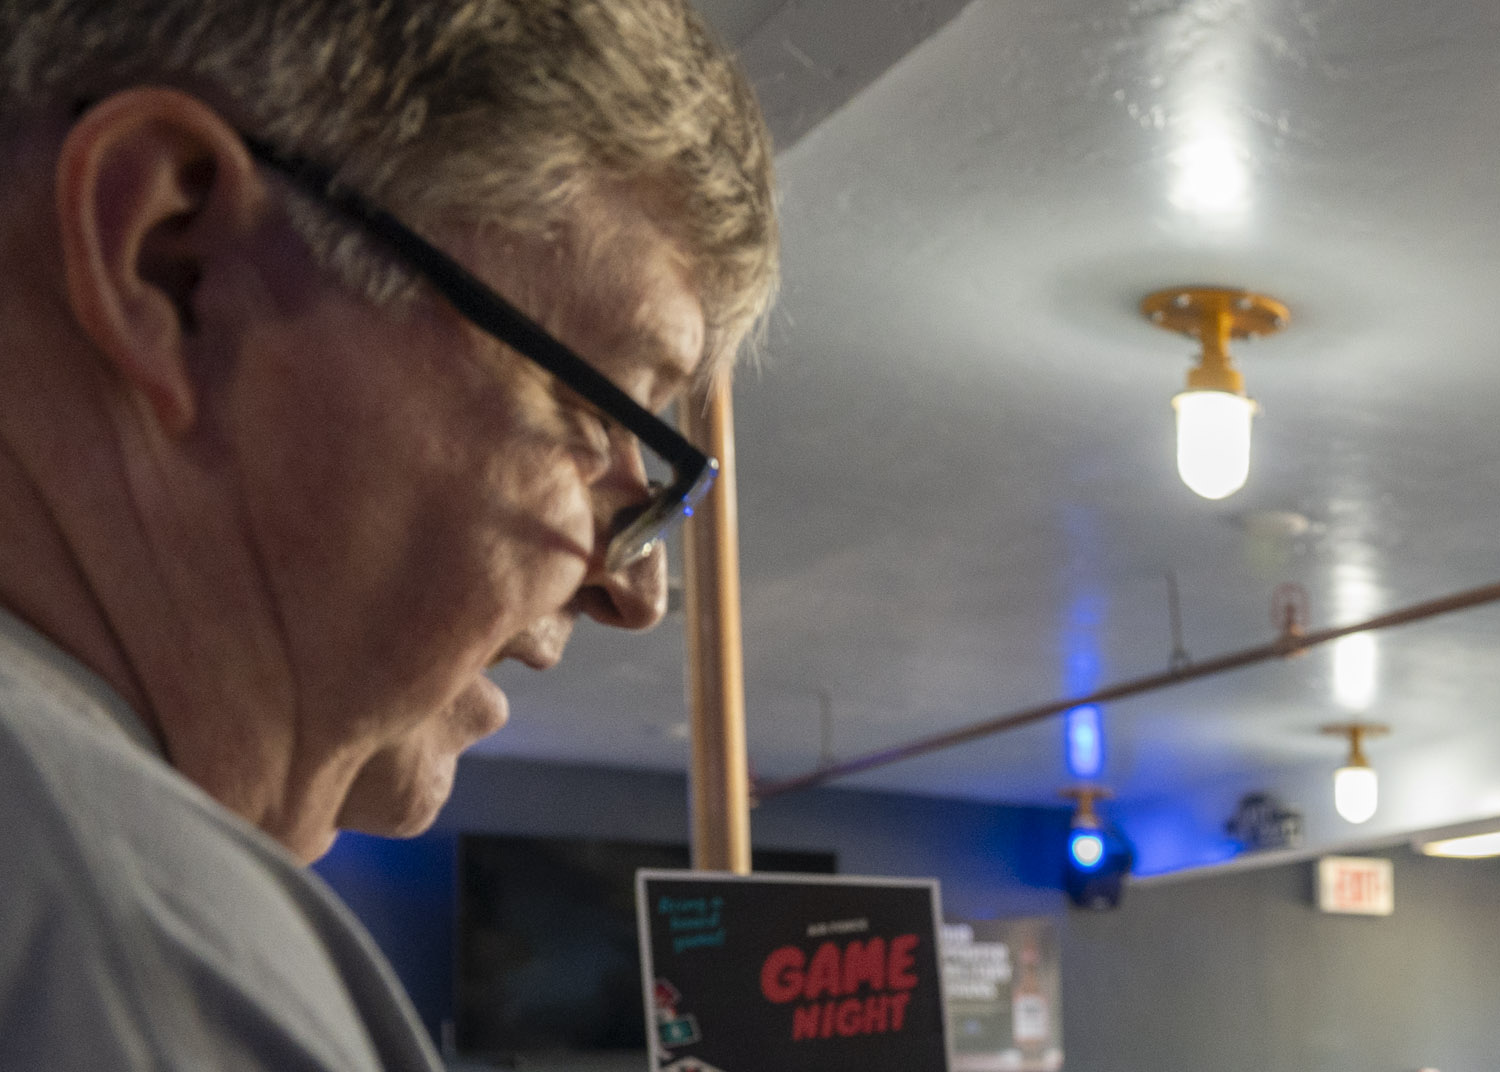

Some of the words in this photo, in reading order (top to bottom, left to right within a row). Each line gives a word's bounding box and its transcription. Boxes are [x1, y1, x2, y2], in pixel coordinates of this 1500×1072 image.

[1334, 868, 1381, 907] EXIT
[760, 933, 919, 1004] GAME
[792, 992, 911, 1042] NIGHT
